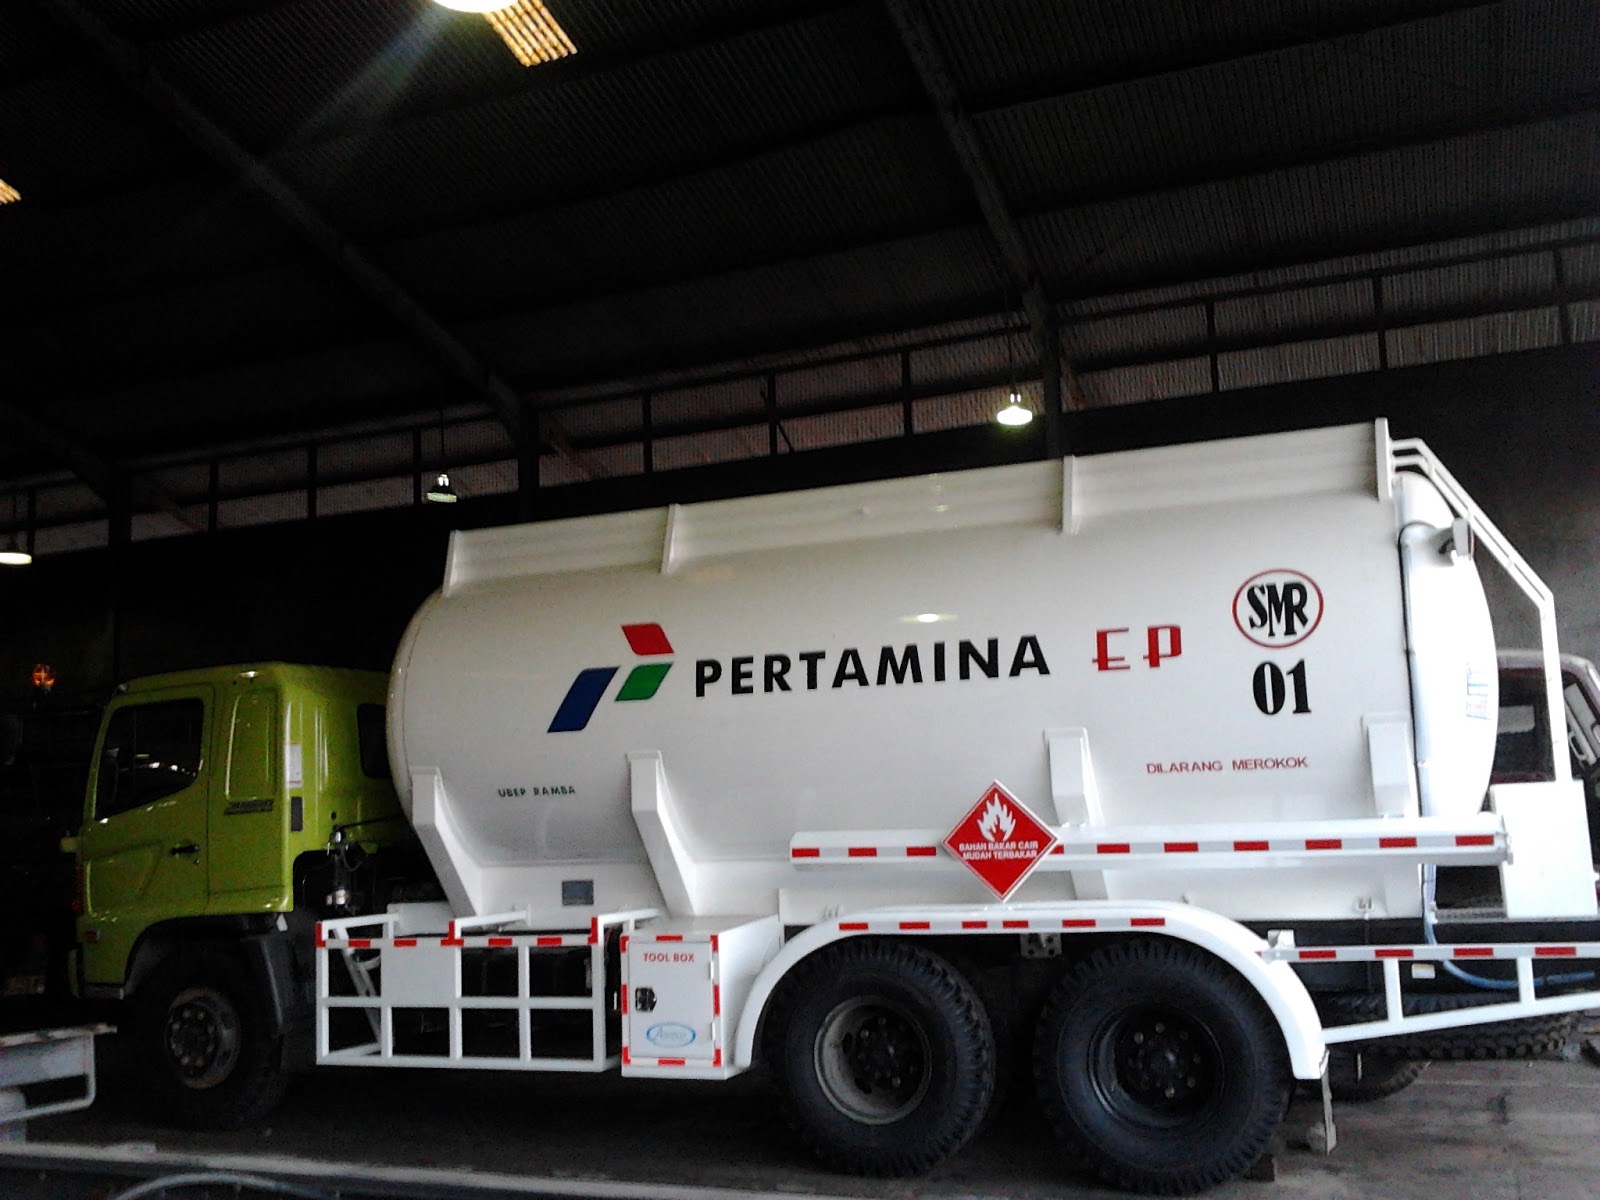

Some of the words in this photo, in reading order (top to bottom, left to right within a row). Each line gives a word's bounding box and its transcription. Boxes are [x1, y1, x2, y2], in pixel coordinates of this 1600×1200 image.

[1246, 581, 1309, 637] SMR
[695, 634, 1051, 698] PERTAMINA
[1092, 624, 1182, 671] EP
[1252, 658, 1312, 715] 01
[1147, 760, 1223, 774] DILARANG
[1232, 756, 1308, 771] MEROKOK
[959, 842, 987, 852] BAHAN
[988, 841, 1017, 851] BAKAR
[1018, 840, 1039, 850] CAIR
[962, 851, 992, 860] MUDAH
[993, 850, 1038, 860] TERBAKAR
[643, 953, 670, 962] TOOL
[673, 953, 695, 962] BOX
